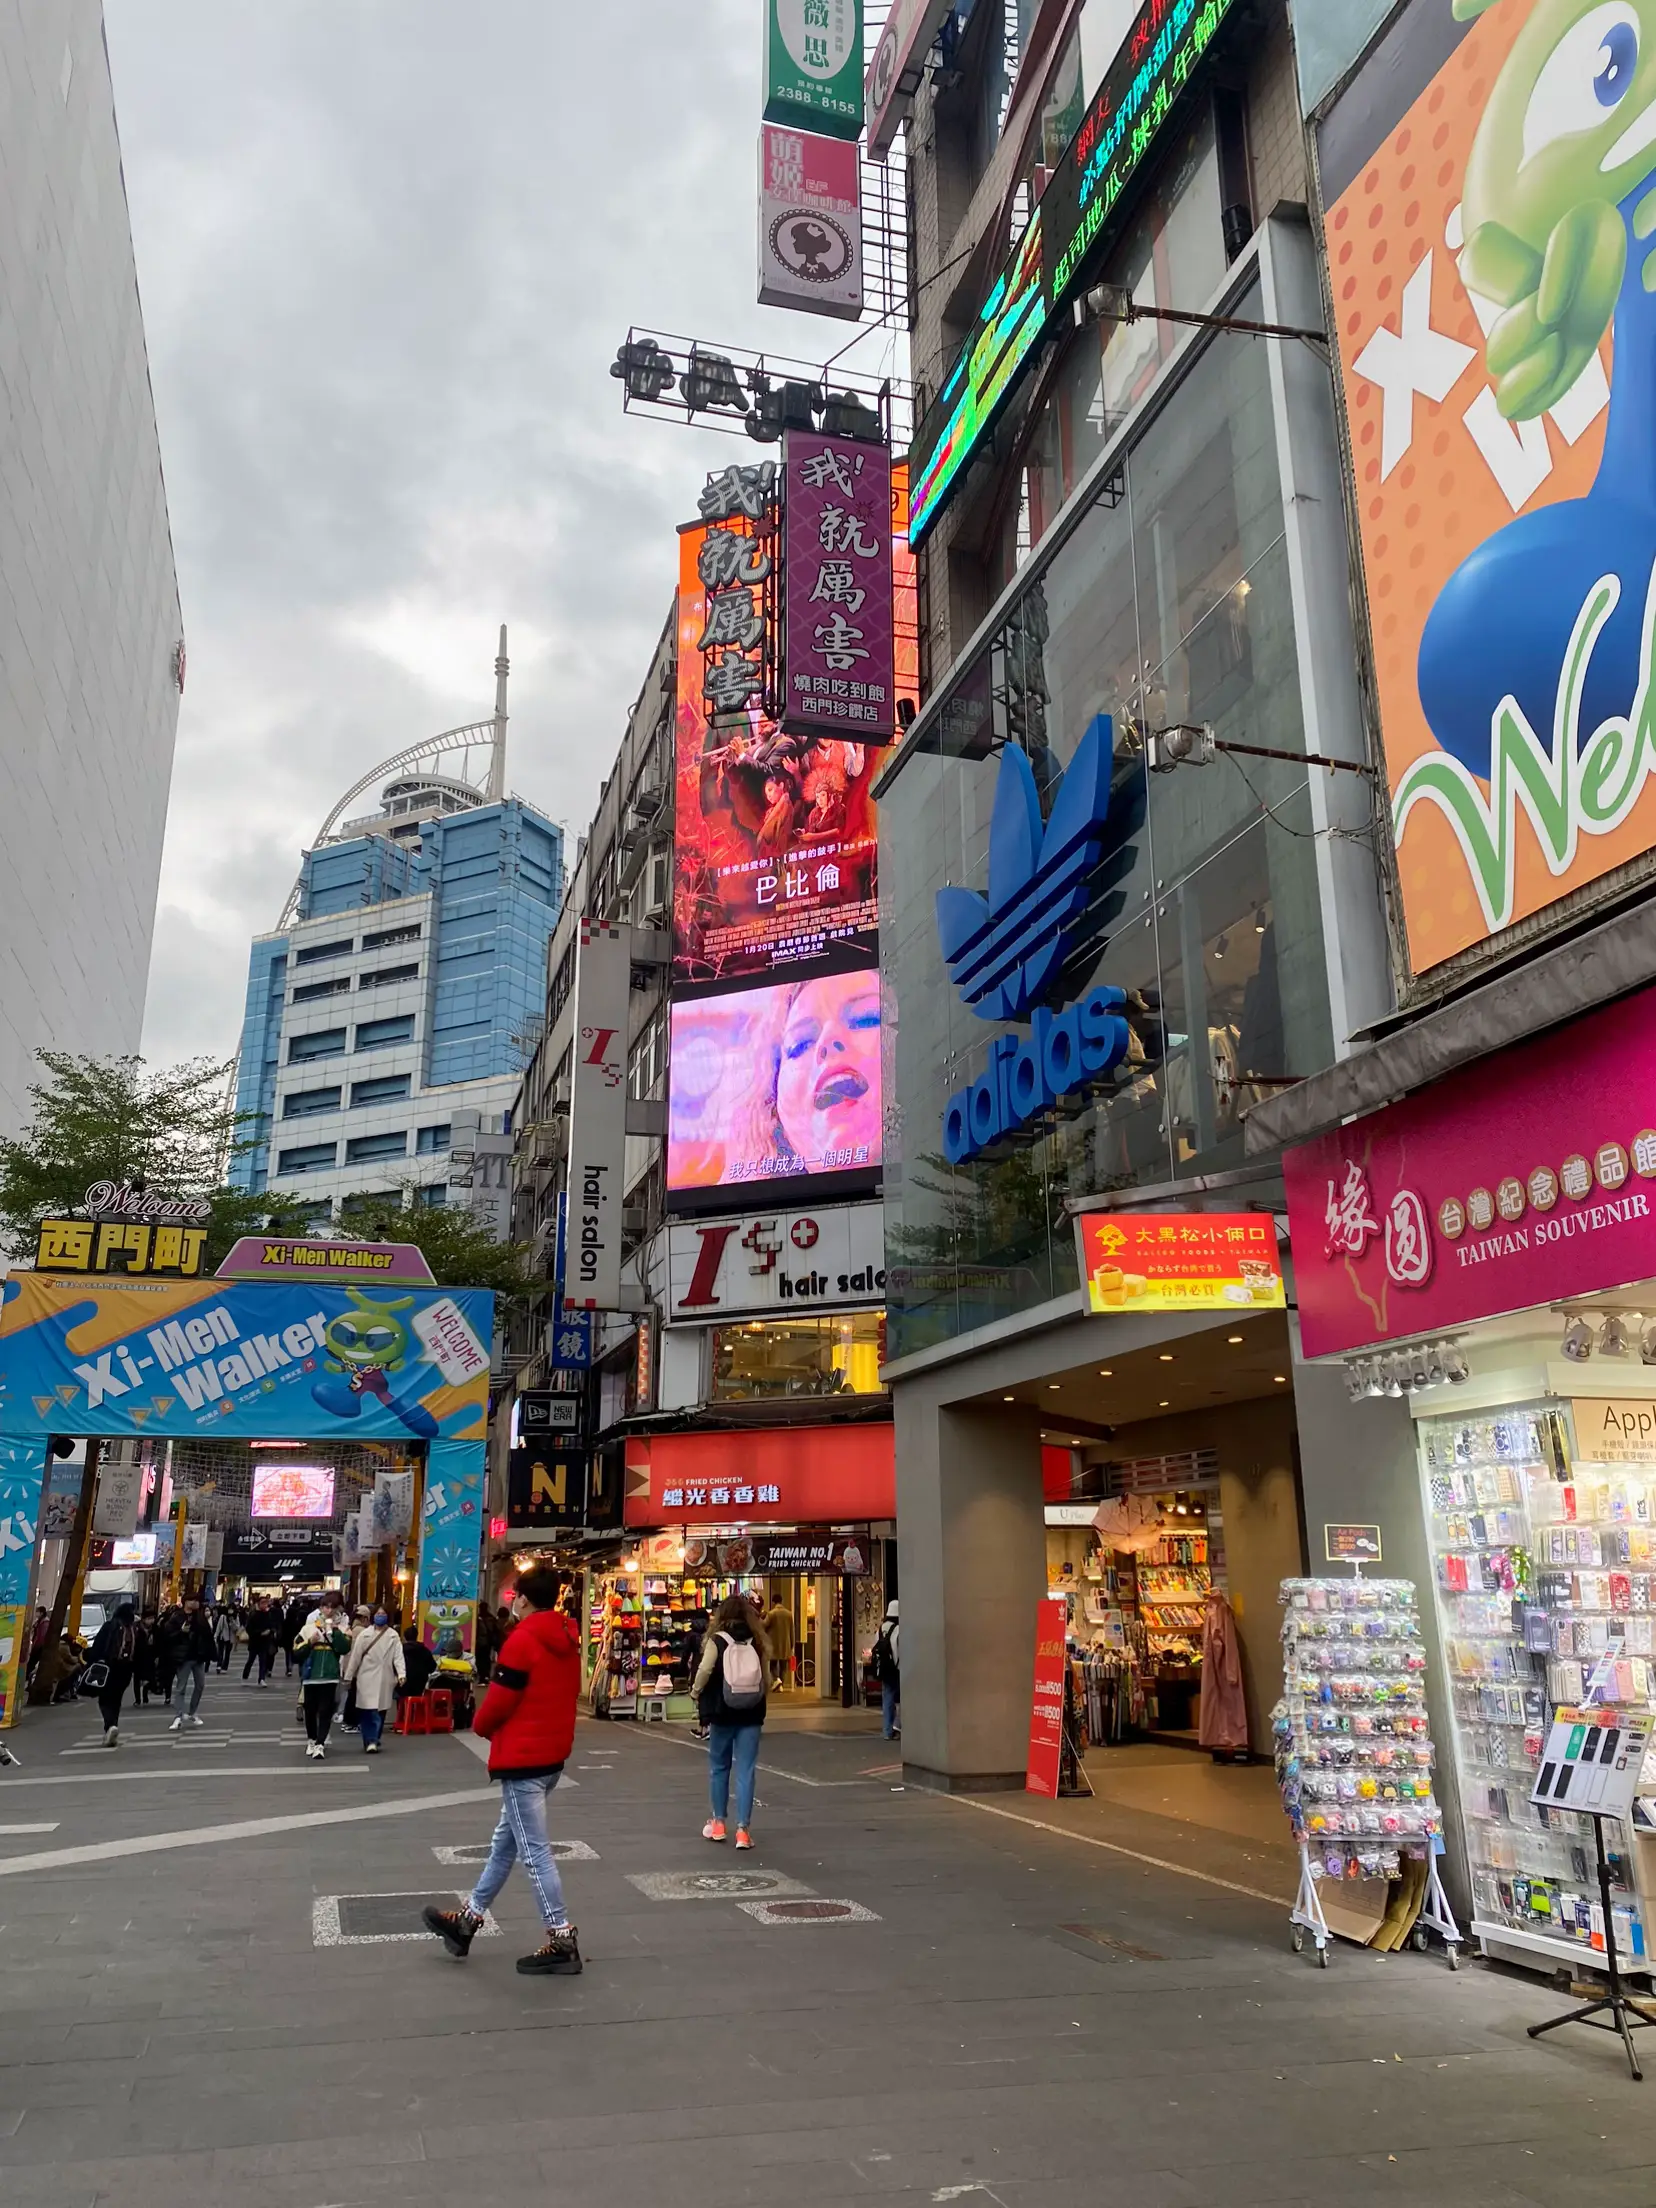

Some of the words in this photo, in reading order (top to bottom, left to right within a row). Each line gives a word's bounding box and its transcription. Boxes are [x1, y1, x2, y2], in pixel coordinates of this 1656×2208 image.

[777, 85, 856, 115] 2388-8155
[793, 673, 886, 704] 燒肉吃到飽
[801, 696, 880, 722] 西門珍饌店
[755, 863, 841, 905] 巴比倫
[771, 947, 797, 959] IMAX
[942, 985, 1130, 1165] adidas
[729, 1146, 871, 1180] 我只想成為一個明星
[84, 1179, 213, 1218] Welcome
[583, 1165, 608, 1210] hair
[1441, 1134, 1656, 1234] 台灣紀念禮品館
[1136, 1226, 1266, 1243] 大黑松小倆口
[1457, 1228, 1530, 1268] TAIWAN
[1535, 1193, 1651, 1247] SOUVENIR
[38, 1218, 209, 1276] 西門町
[262, 1244, 327, 1266] Xi-Men
[328, 1246, 394, 1270] Walker
[579, 1215, 605, 1283] salon
[778, 1269, 829, 1299] hair
[432, 1304, 484, 1373] WELCOME
[557, 1310, 589, 1361] 眼鏡
[72, 1305, 241, 1411] Xi-Men
[169, 1311, 328, 1412] Walker
[553, 1405, 573, 1413] NEW
[553, 1413, 573, 1421] ERA
[662, 1484, 781, 1507] 繼光香香雞
[685, 1477, 708, 1486] FRIED
[709, 1476, 743, 1485] CHICKEN
[768, 1547, 808, 1560] TAIWAN
[809, 1542, 834, 1561] NO.1
[768, 1560, 789, 1568] FRIED
[790, 1559, 821, 1568] CHICKEN
